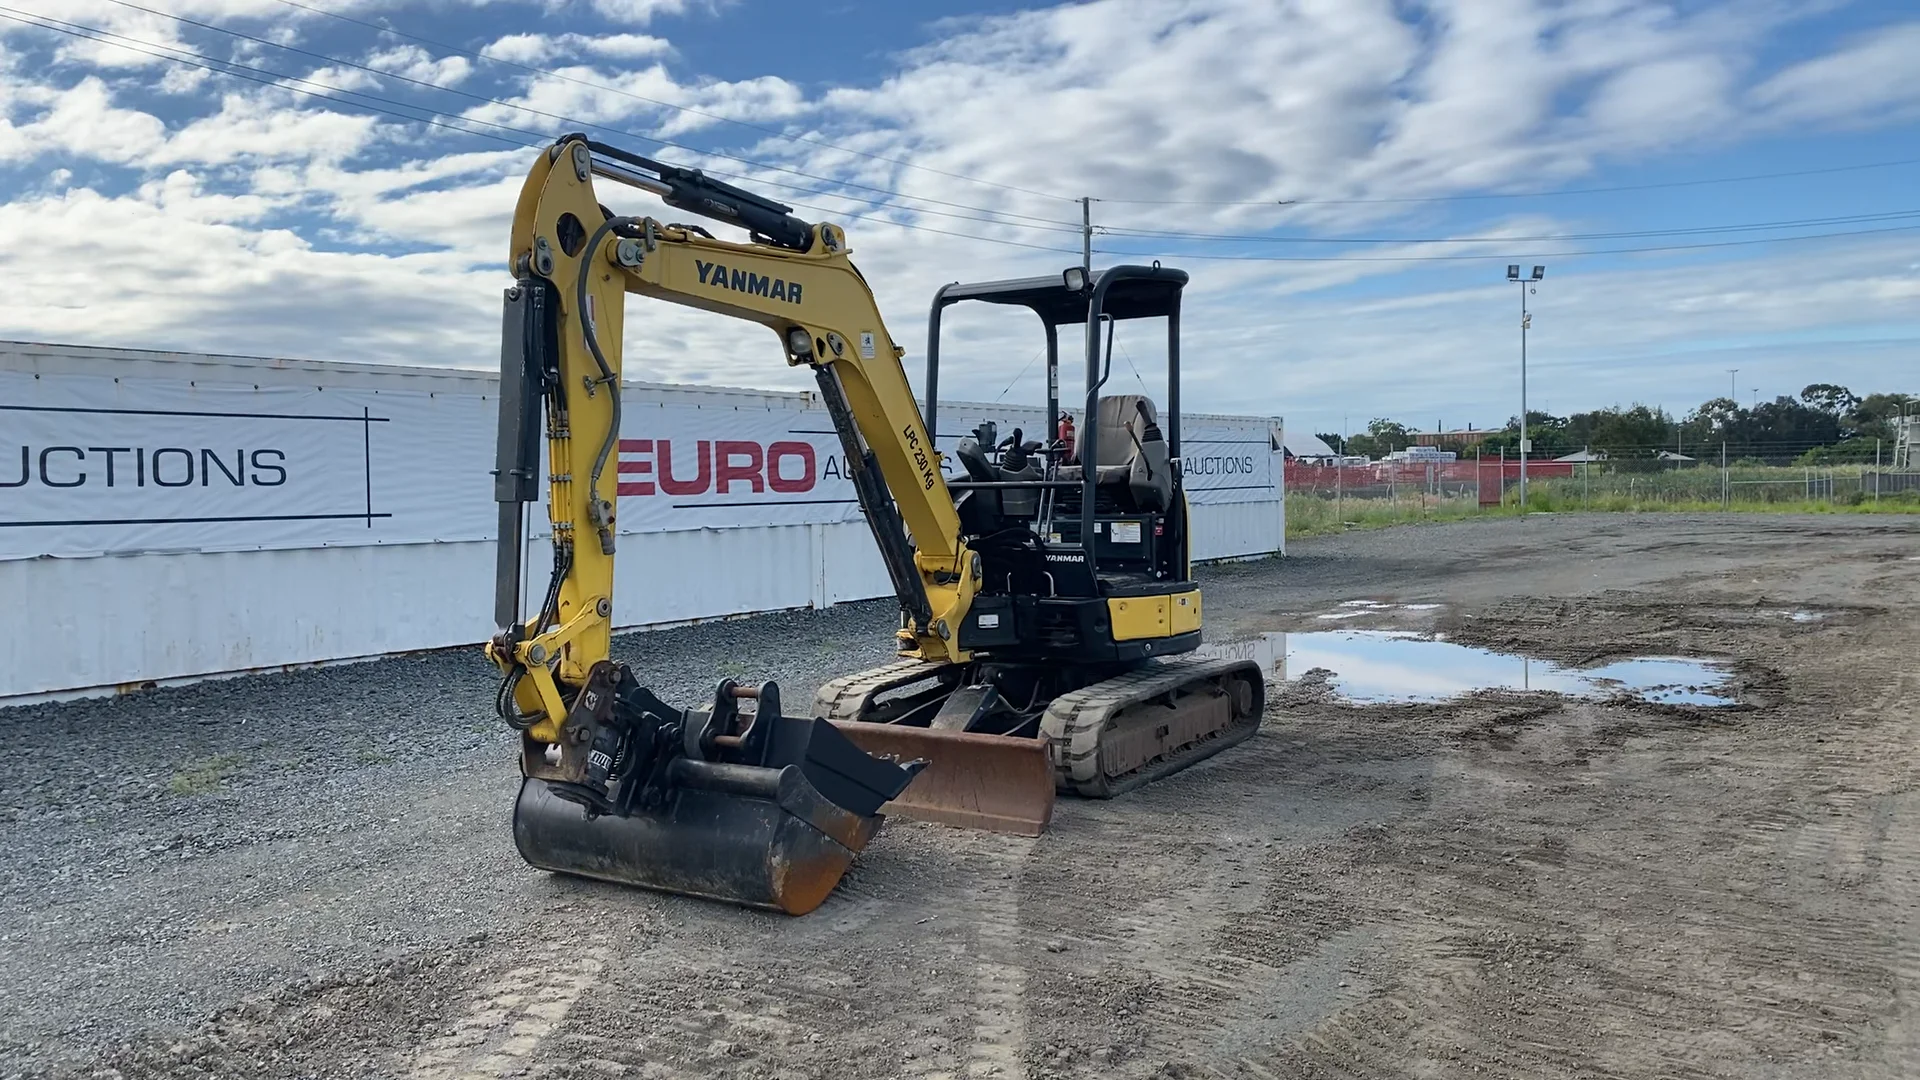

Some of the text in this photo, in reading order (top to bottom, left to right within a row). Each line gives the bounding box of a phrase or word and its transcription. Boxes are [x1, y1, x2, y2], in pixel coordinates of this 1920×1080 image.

[695, 259, 803, 305] YANMAR
[617, 439, 816, 496] EURO
[903, 424, 935, 490] LPC 230 Kg
[1183, 456, 1253, 475] AUCTIONS
[1045, 554, 1084, 563] YANMAR
